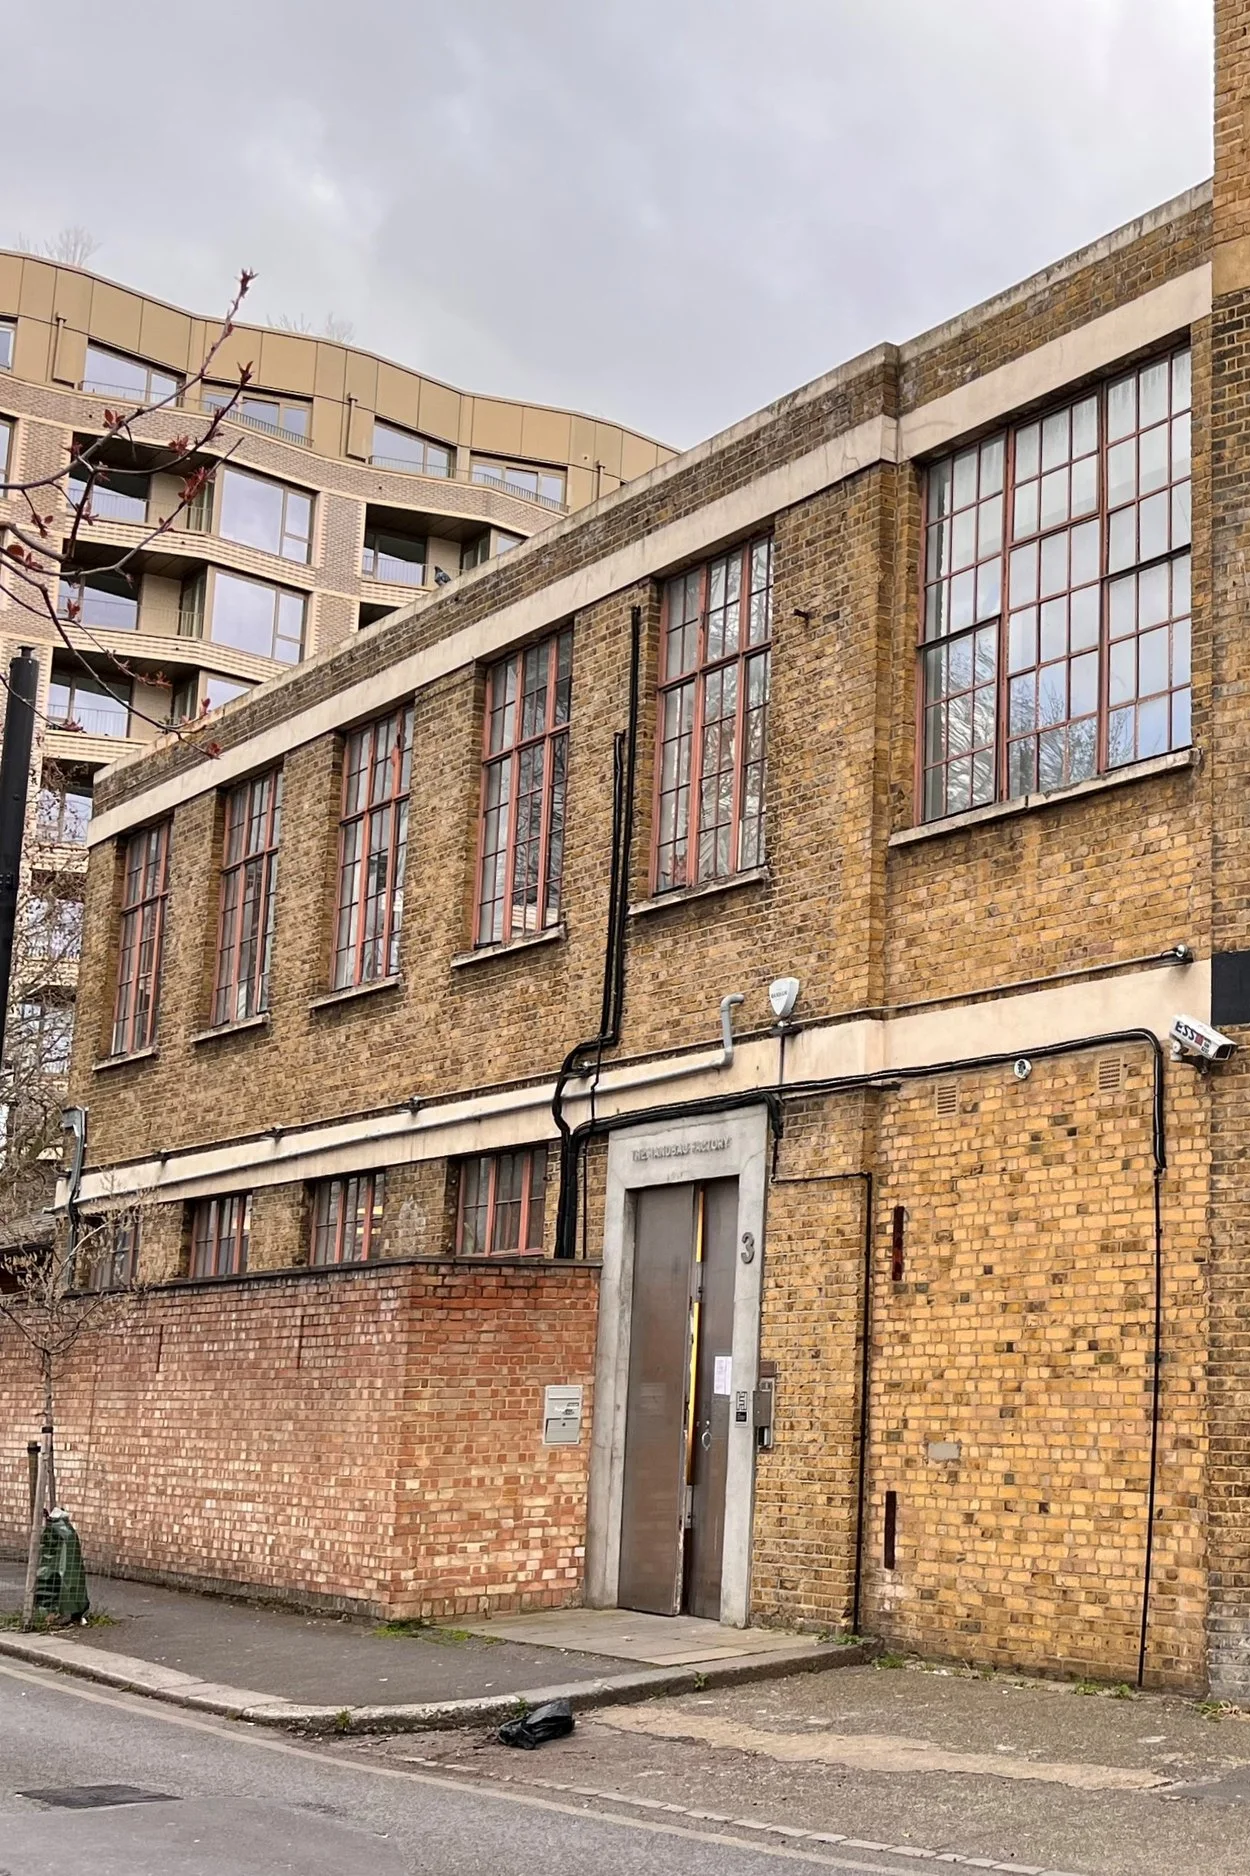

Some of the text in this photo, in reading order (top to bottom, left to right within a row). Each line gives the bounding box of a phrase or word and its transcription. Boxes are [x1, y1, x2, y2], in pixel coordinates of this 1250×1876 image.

[632, 1149, 649, 1161] THE
[691, 1136, 733, 1154] FACTORY
[741, 1231, 755, 1264] 3
